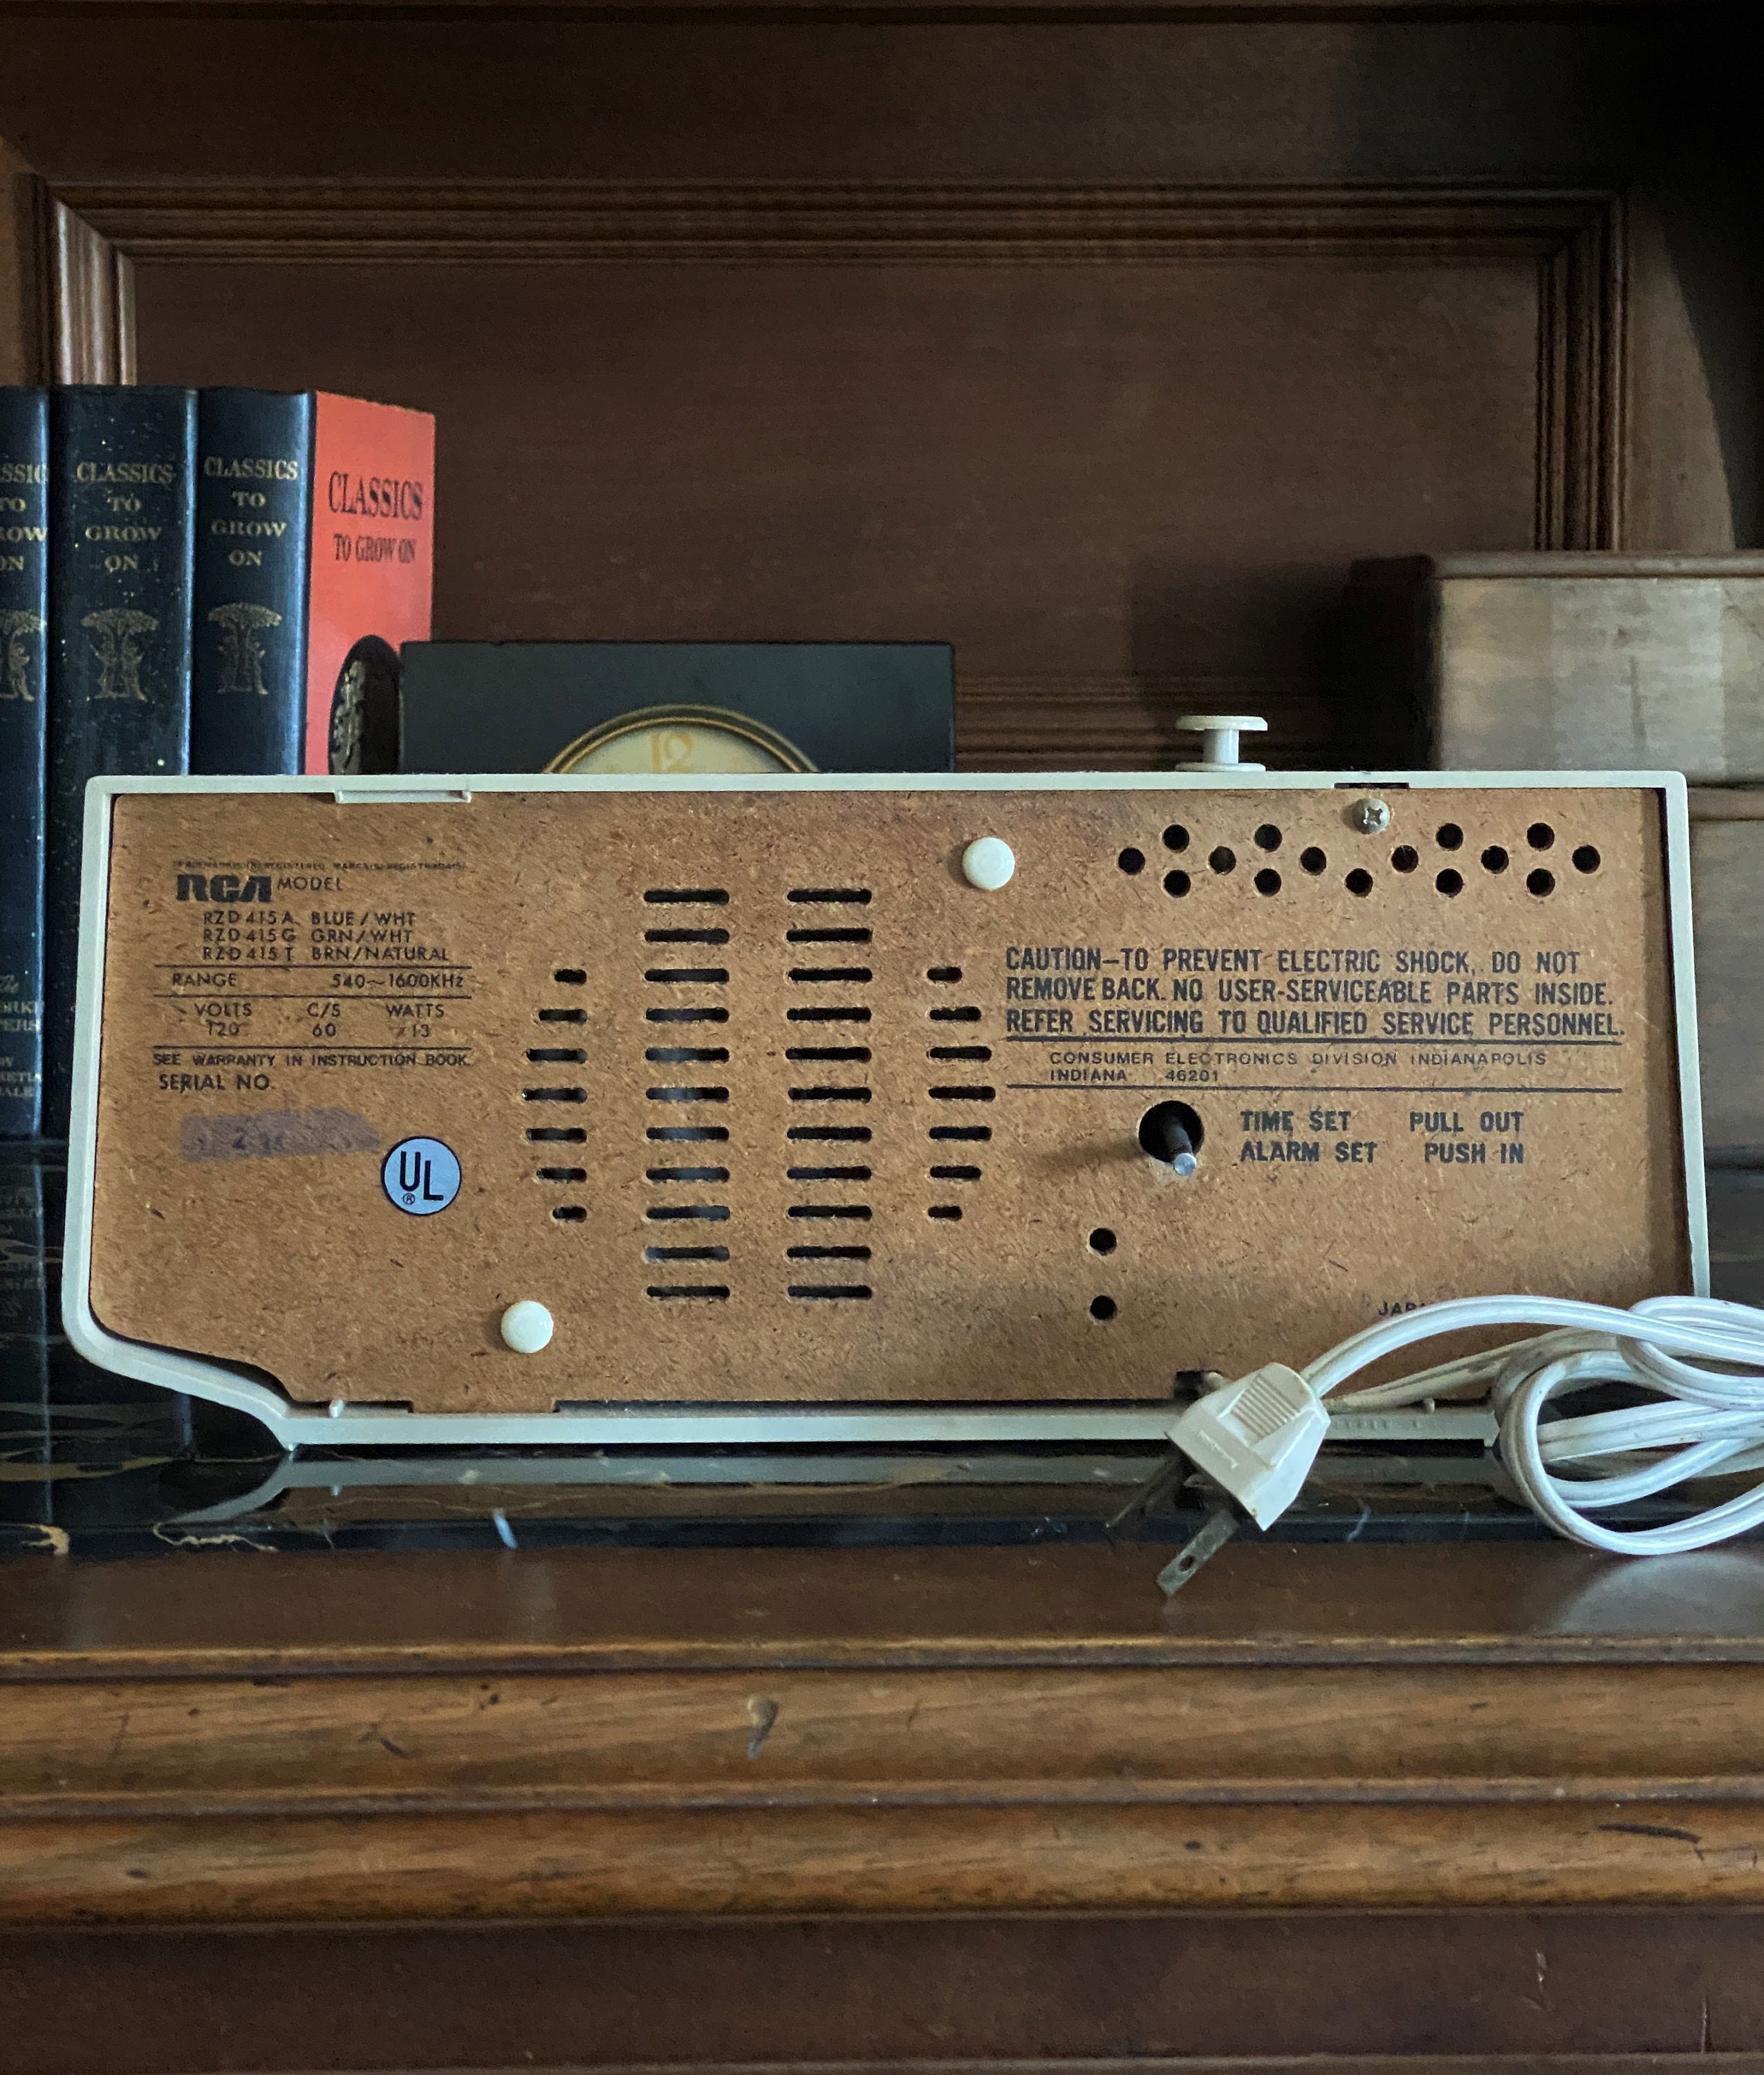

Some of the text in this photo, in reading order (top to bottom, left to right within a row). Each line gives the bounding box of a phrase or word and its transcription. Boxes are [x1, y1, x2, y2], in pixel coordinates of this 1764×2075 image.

[76, 462, 174, 483] CLASSICS
[204, 457, 298, 481] CLASSICS
[106, 495, 142, 513] TO
[231, 492, 266, 508] TO
[328, 471, 423, 521] CLASSICS
[84, 525, 162, 542] GROW
[210, 521, 287, 538] GROW
[333, 533, 416, 564] TO GROW ON
[104, 554, 138, 573] ON
[228, 550, 263, 567] ON
[176, 874, 344, 903] RCA MODEL
[1162, 948, 1263, 972] PREVENT
[1277, 949, 1380, 973] ELECTRIC
[1395, 950, 1476, 976] SHOCK,
[1492, 950, 1521, 973] DO
[1536, 950, 1581, 975] NOT
[171, 972, 237, 987] RANGE
[1005, 977, 1096, 1001] REMOVE
[1102, 977, 1166, 1002] BACK.
[1173, 978, 1203, 1002] NO
[1447, 981, 1519, 1005] PARTS
[1534, 981, 1613, 1006] INSIDE.
[194, 1003, 445, 1018] VOLTS C/S WATTS
[207, 1023, 240, 1037] 120
[312, 1023, 337, 1038] 60
[1005, 1008, 1625, 1037] REFER SERVICING TO QUALIFIED SERVICE PERSONNEL.
[152, 1053, 180, 1066] SEE
[192, 1053, 276, 1067] WARRANTY
[286, 1054, 303, 1067] IN
[311, 1054, 416, 1067] INSTRUCTION
[1050, 1051, 1547, 1067] CONSUMER ELECTRONICS DIVISION INDIANAPOLIS
[159, 1074, 225, 1091] SERIAL
[1050, 1069, 1219, 1083] INDIANA 46201
[1239, 1109, 1352, 1132] TIME SET
[1409, 1111, 1525, 1134] PULL OUT
[1239, 1139, 1378, 1164] ALARM SET
[1424, 1142, 1525, 1165] PUSH IN
[399, 1150, 444, 1201] UL
[1378, 1300, 1426, 1317] JAP
